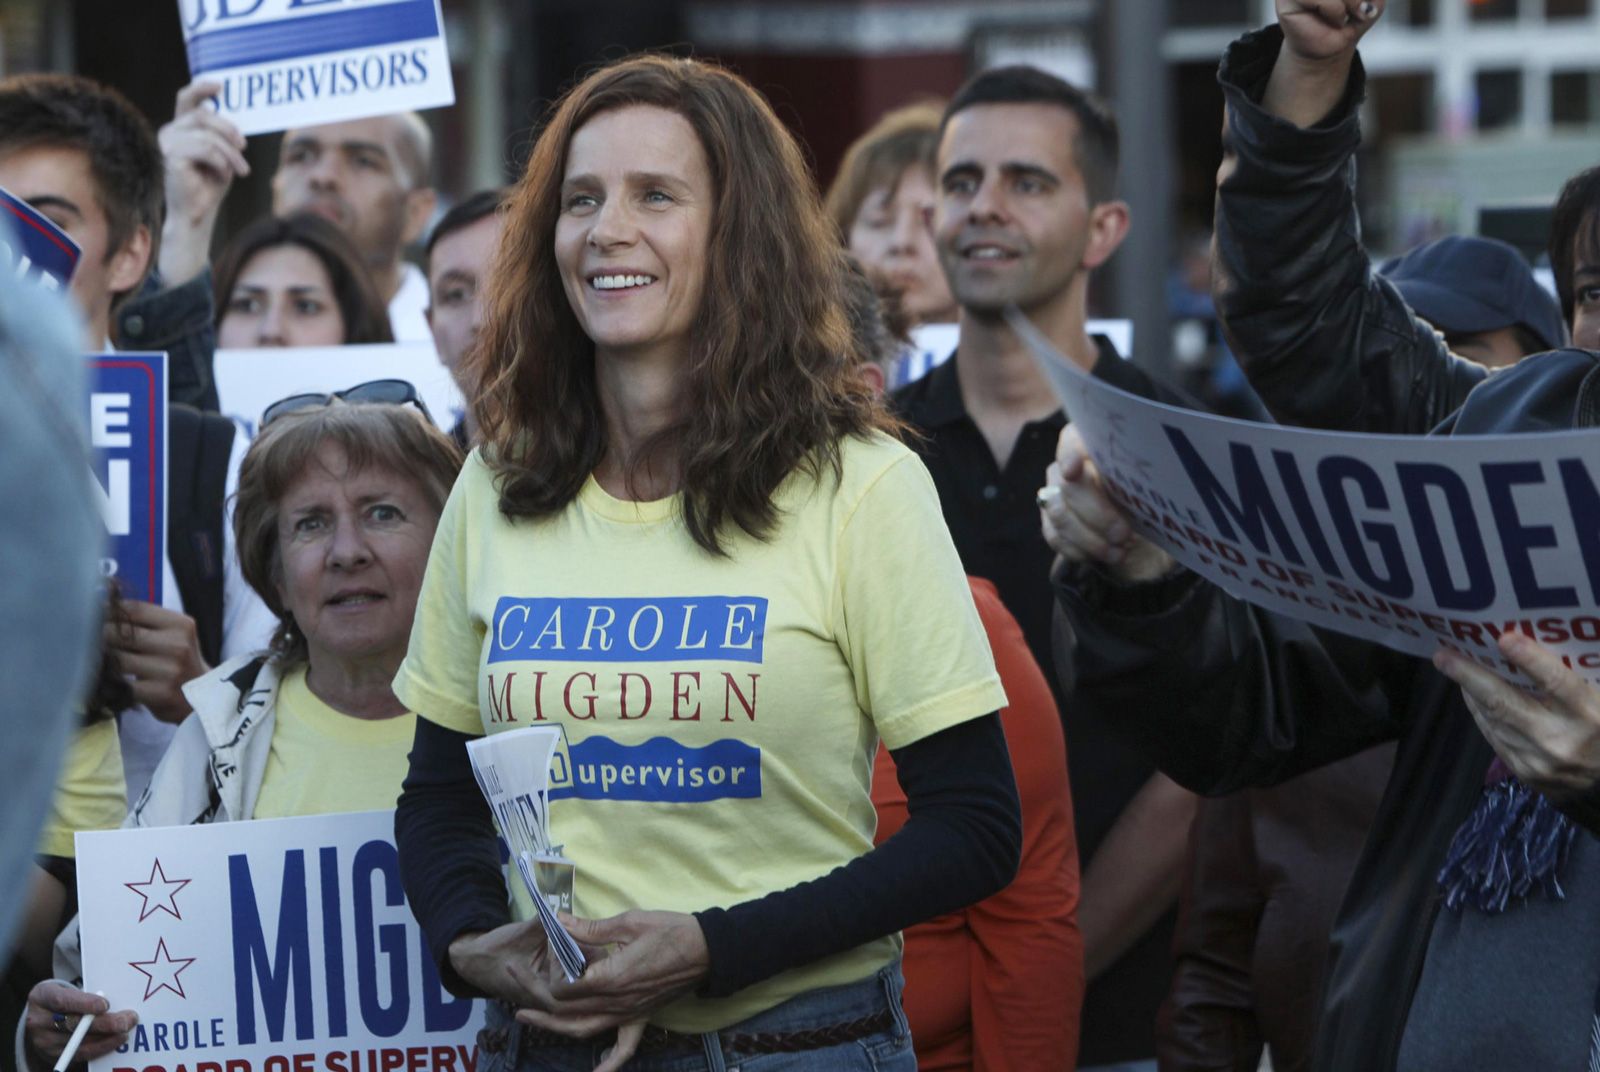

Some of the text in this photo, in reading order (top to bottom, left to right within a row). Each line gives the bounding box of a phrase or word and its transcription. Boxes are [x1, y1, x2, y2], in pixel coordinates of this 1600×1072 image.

[1256, 557, 1315, 589] OF
[498, 604, 756, 651] CAROLE
[487, 671, 761, 723] MIGDEN
